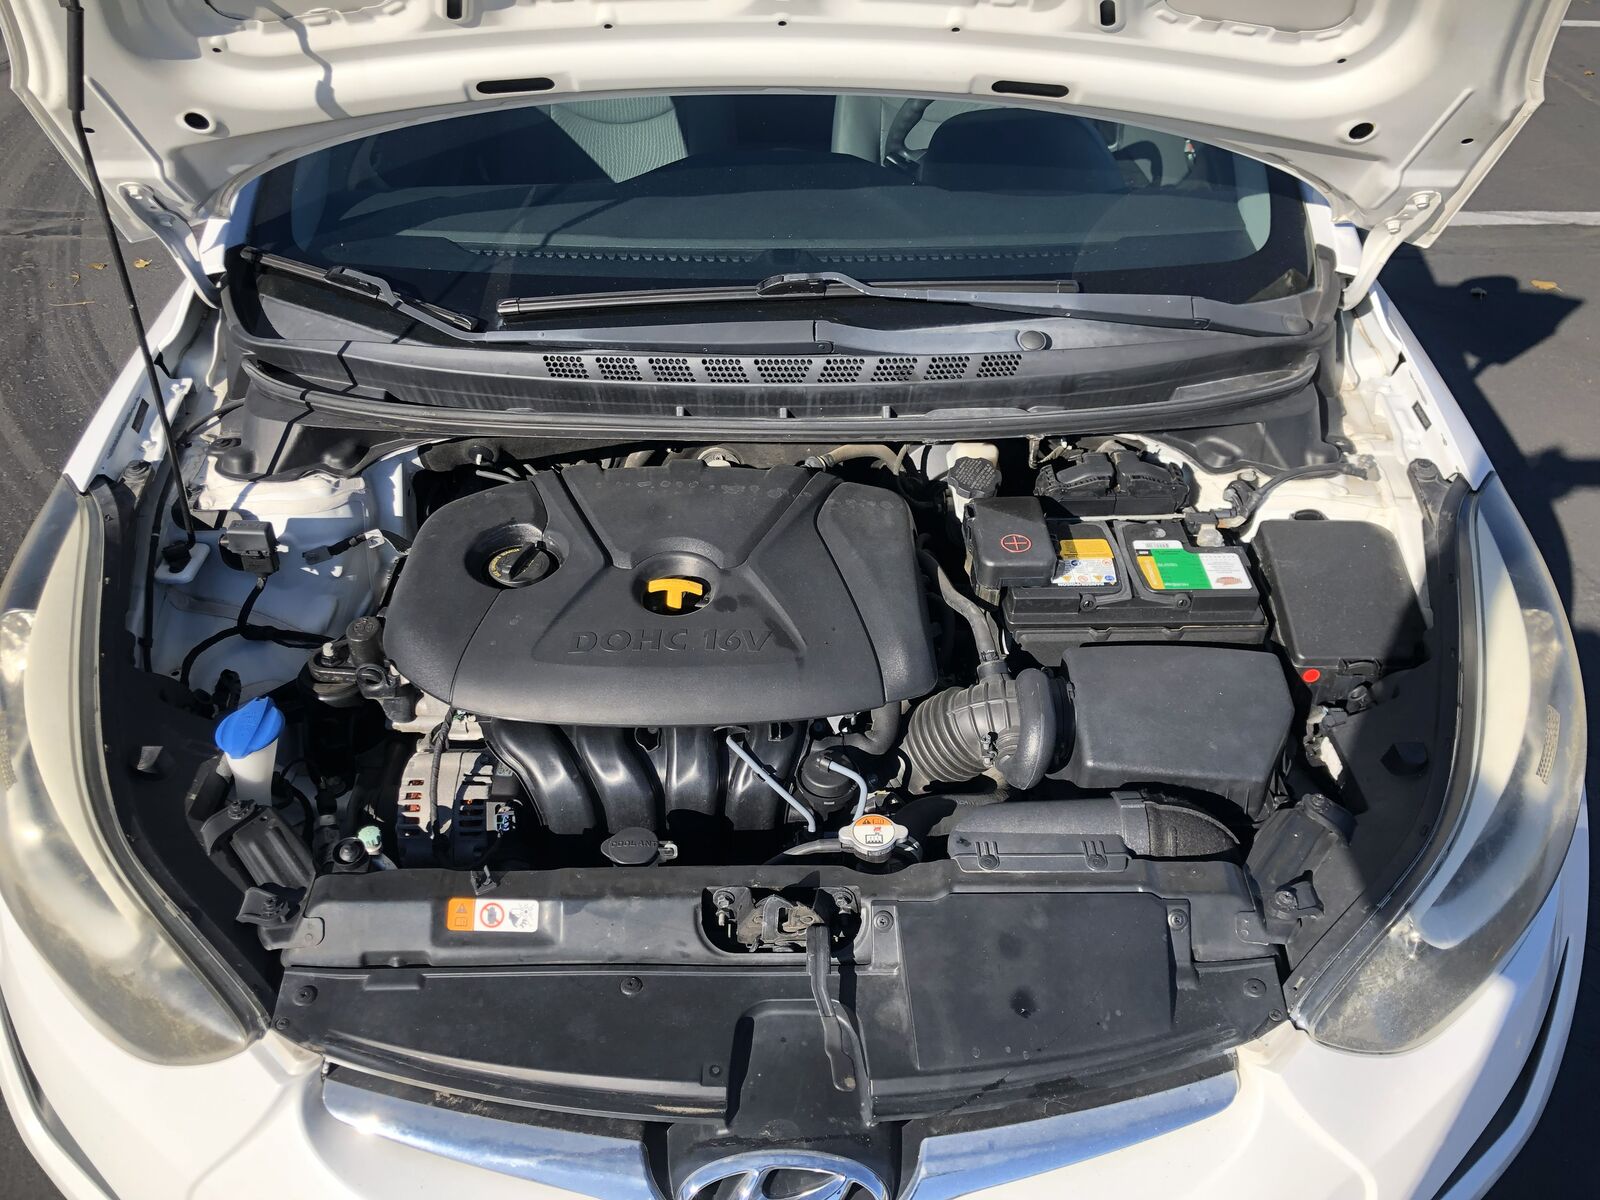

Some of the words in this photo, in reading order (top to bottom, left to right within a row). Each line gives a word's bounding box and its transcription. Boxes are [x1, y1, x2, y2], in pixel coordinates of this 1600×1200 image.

[568, 629, 688, 653] DOHC
[704, 629, 773, 652] 16V
[609, 840, 658, 848] COOLANT
